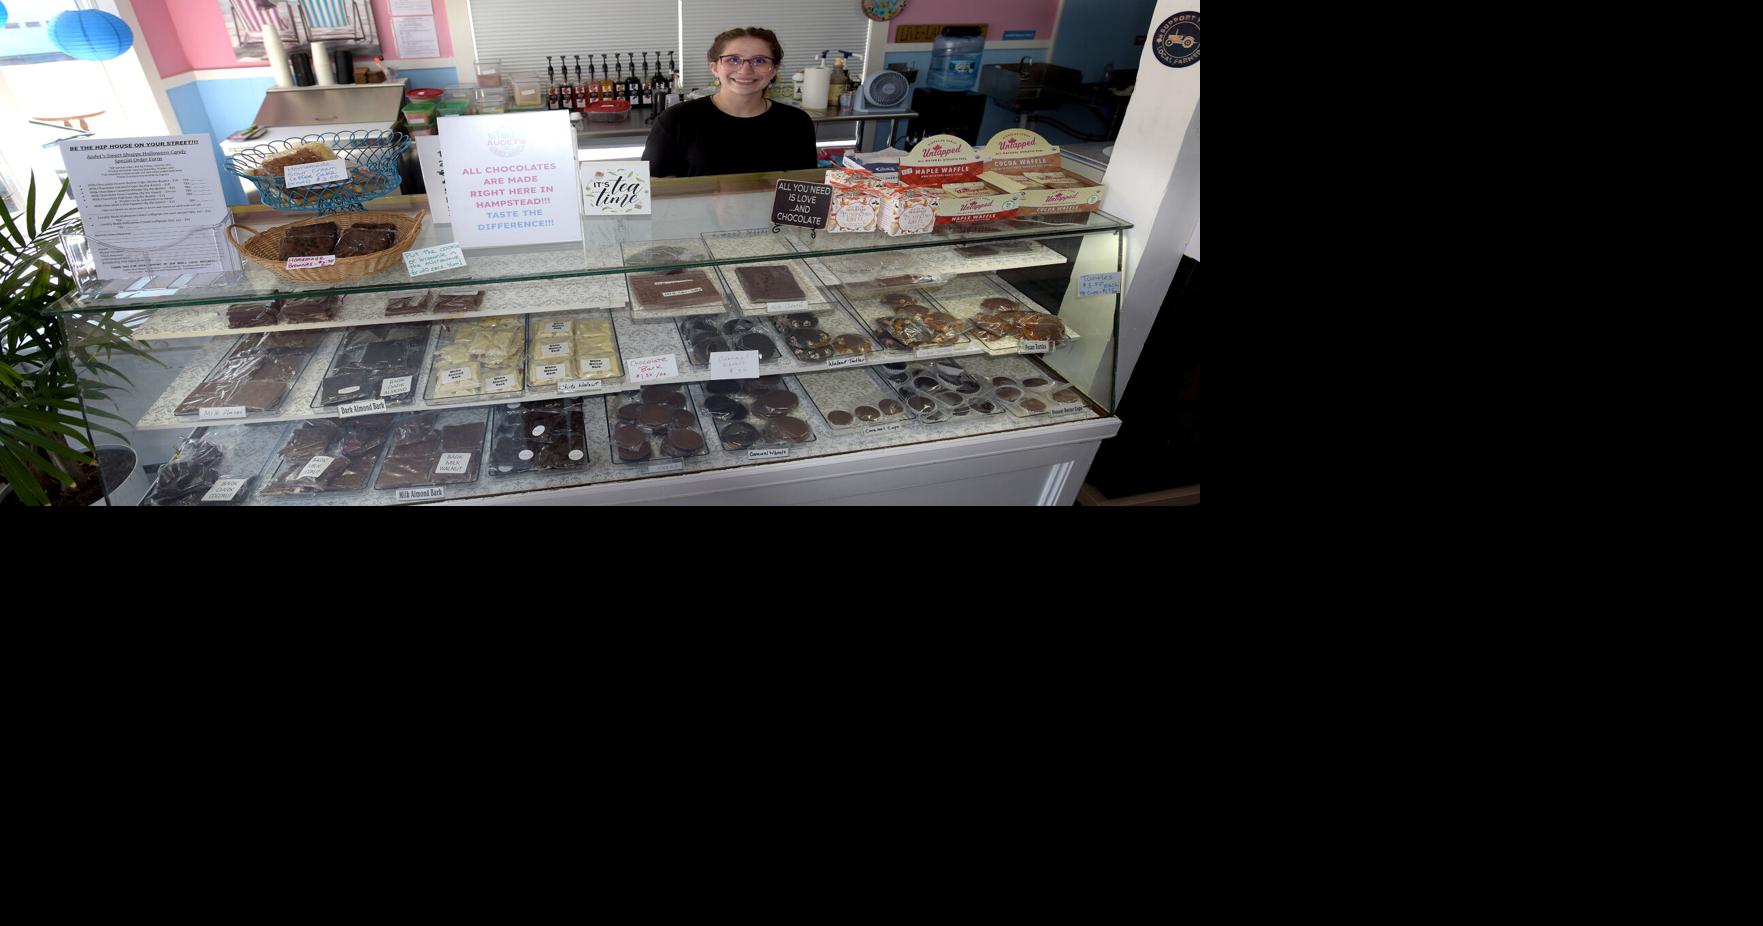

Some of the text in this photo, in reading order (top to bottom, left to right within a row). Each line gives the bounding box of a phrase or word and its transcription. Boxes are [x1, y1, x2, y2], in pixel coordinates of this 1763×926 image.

[1160, 15, 1196, 33] SUPPORT
[1157, 46, 1173, 63] LOCAL
[462, 162, 557, 176] ALL CHOCOLATES
[483, 175, 537, 185] ARE MADE
[612, 176, 640, 194] tea
[470, 189, 505, 198] RIGHT
[509, 187, 536, 195] HERE
[793, 184, 809, 193] YOU
[810, 186, 831, 195] NEED
[476, 197, 551, 208] HAMPSTEAD!!!
[596, 188, 639, 207] time
[789, 193, 816, 204] IS LOVE
[486, 210, 519, 219] TASTE
[777, 212, 822, 225] CHOCOLATE
[477, 220, 555, 231] DIFFERENCE!!!
[354, 404, 372, 412] Almond
[411, 489, 429, 498] Almond
